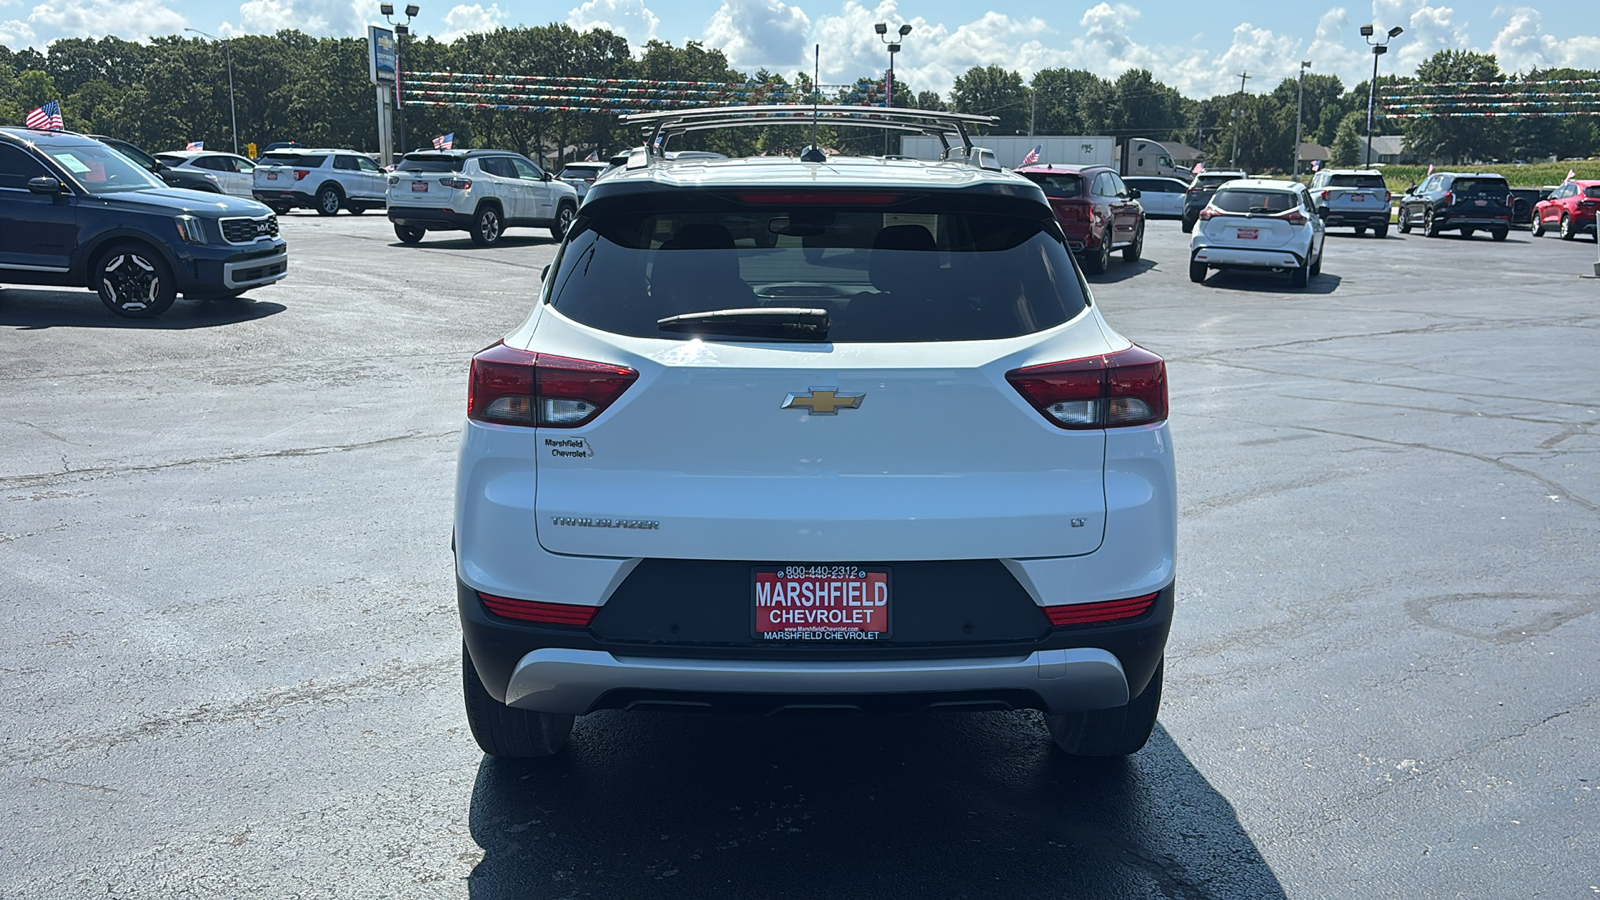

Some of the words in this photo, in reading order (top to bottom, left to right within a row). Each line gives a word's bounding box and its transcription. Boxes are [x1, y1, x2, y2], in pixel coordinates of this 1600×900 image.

[545, 439, 583, 447] Marshfield
[552, 449, 586, 457] Chevrolet
[551, 516, 660, 530] TRAILBLAZER
[1071, 518, 1087, 528] LT
[786, 566, 858, 575] 800-440-2312
[755, 581, 888, 607] MARSHFIELD
[769, 609, 874, 624] CHEVROLET
[764, 631, 822, 640] MARSHFIELD
[824, 631, 880, 640] CHEVROLET
